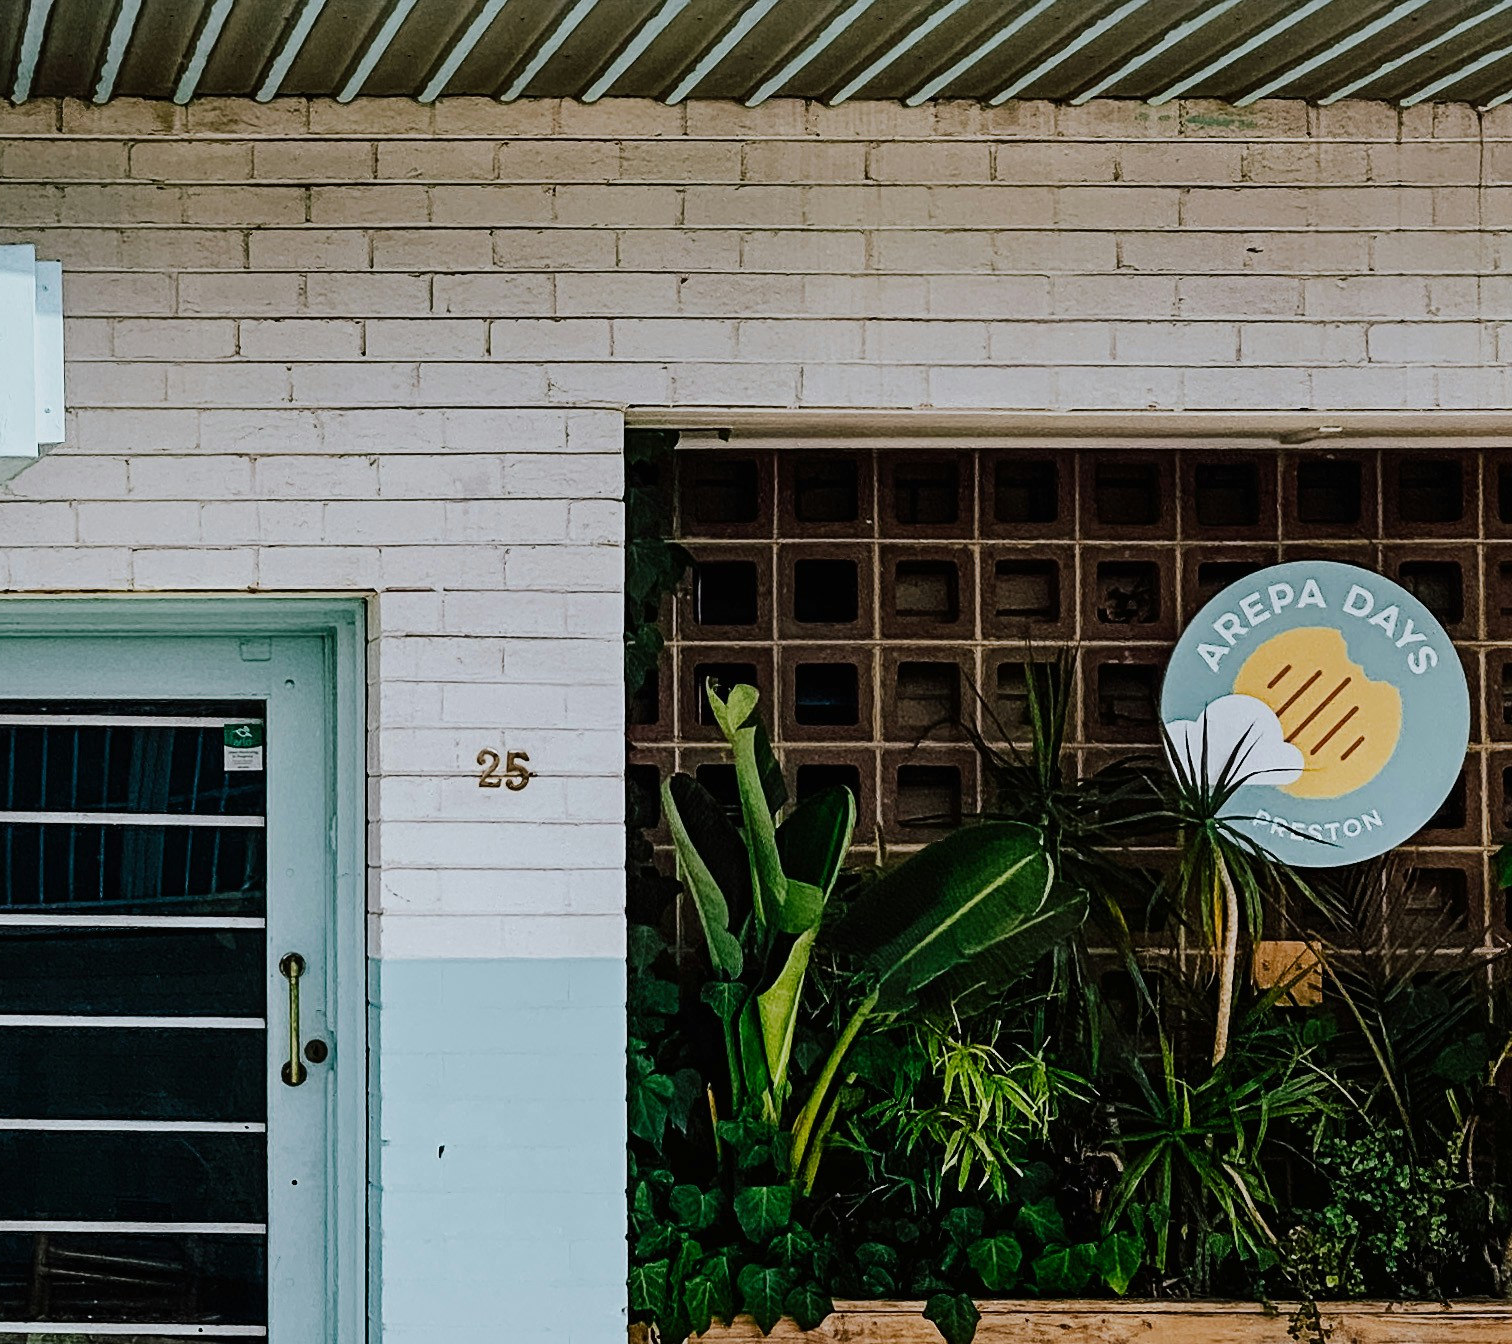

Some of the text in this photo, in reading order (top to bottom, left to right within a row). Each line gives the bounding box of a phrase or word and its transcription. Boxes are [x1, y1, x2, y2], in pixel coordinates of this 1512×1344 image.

[1196, 579, 1438, 674] AREPA DAYS
[476, 747, 530, 791] 25
[1252, 809, 1384, 842] PRESTON
